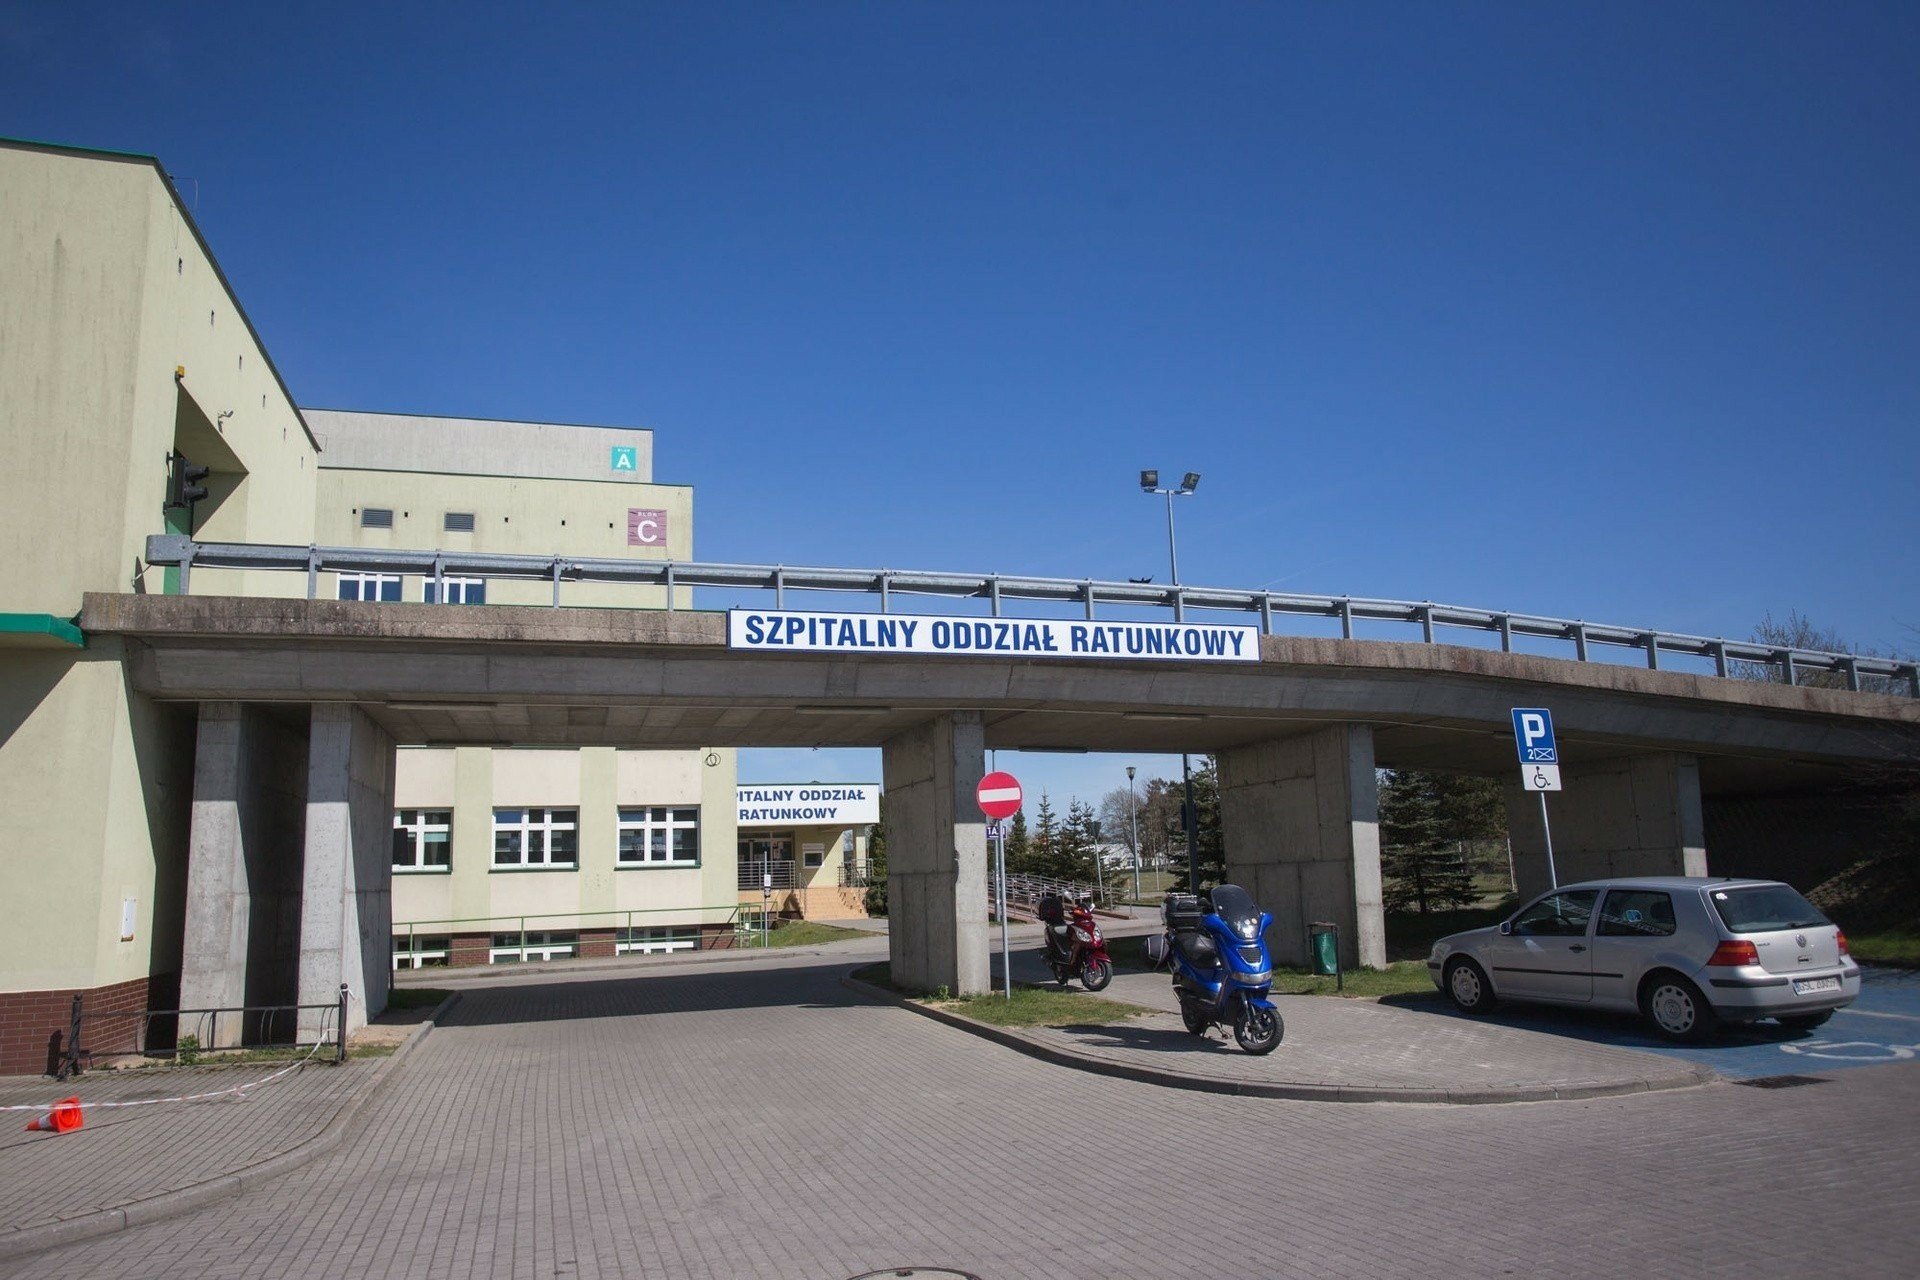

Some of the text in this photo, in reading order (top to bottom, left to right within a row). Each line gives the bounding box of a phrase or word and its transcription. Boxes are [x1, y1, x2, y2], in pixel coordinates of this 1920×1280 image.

[616, 453, 632, 468] A
[637, 519, 658, 542] C
[745, 615, 1245, 656] SZPITALNY ODDZIAŁ RATUNKOWY
[1521, 713, 1546, 747] P
[1527, 748, 1535, 760] 2
[736, 789, 866, 802] ITALNY ODDZIAŁ
[739, 807, 838, 820] RATUNKOWY
[987, 826, 1006, 836] TAI
